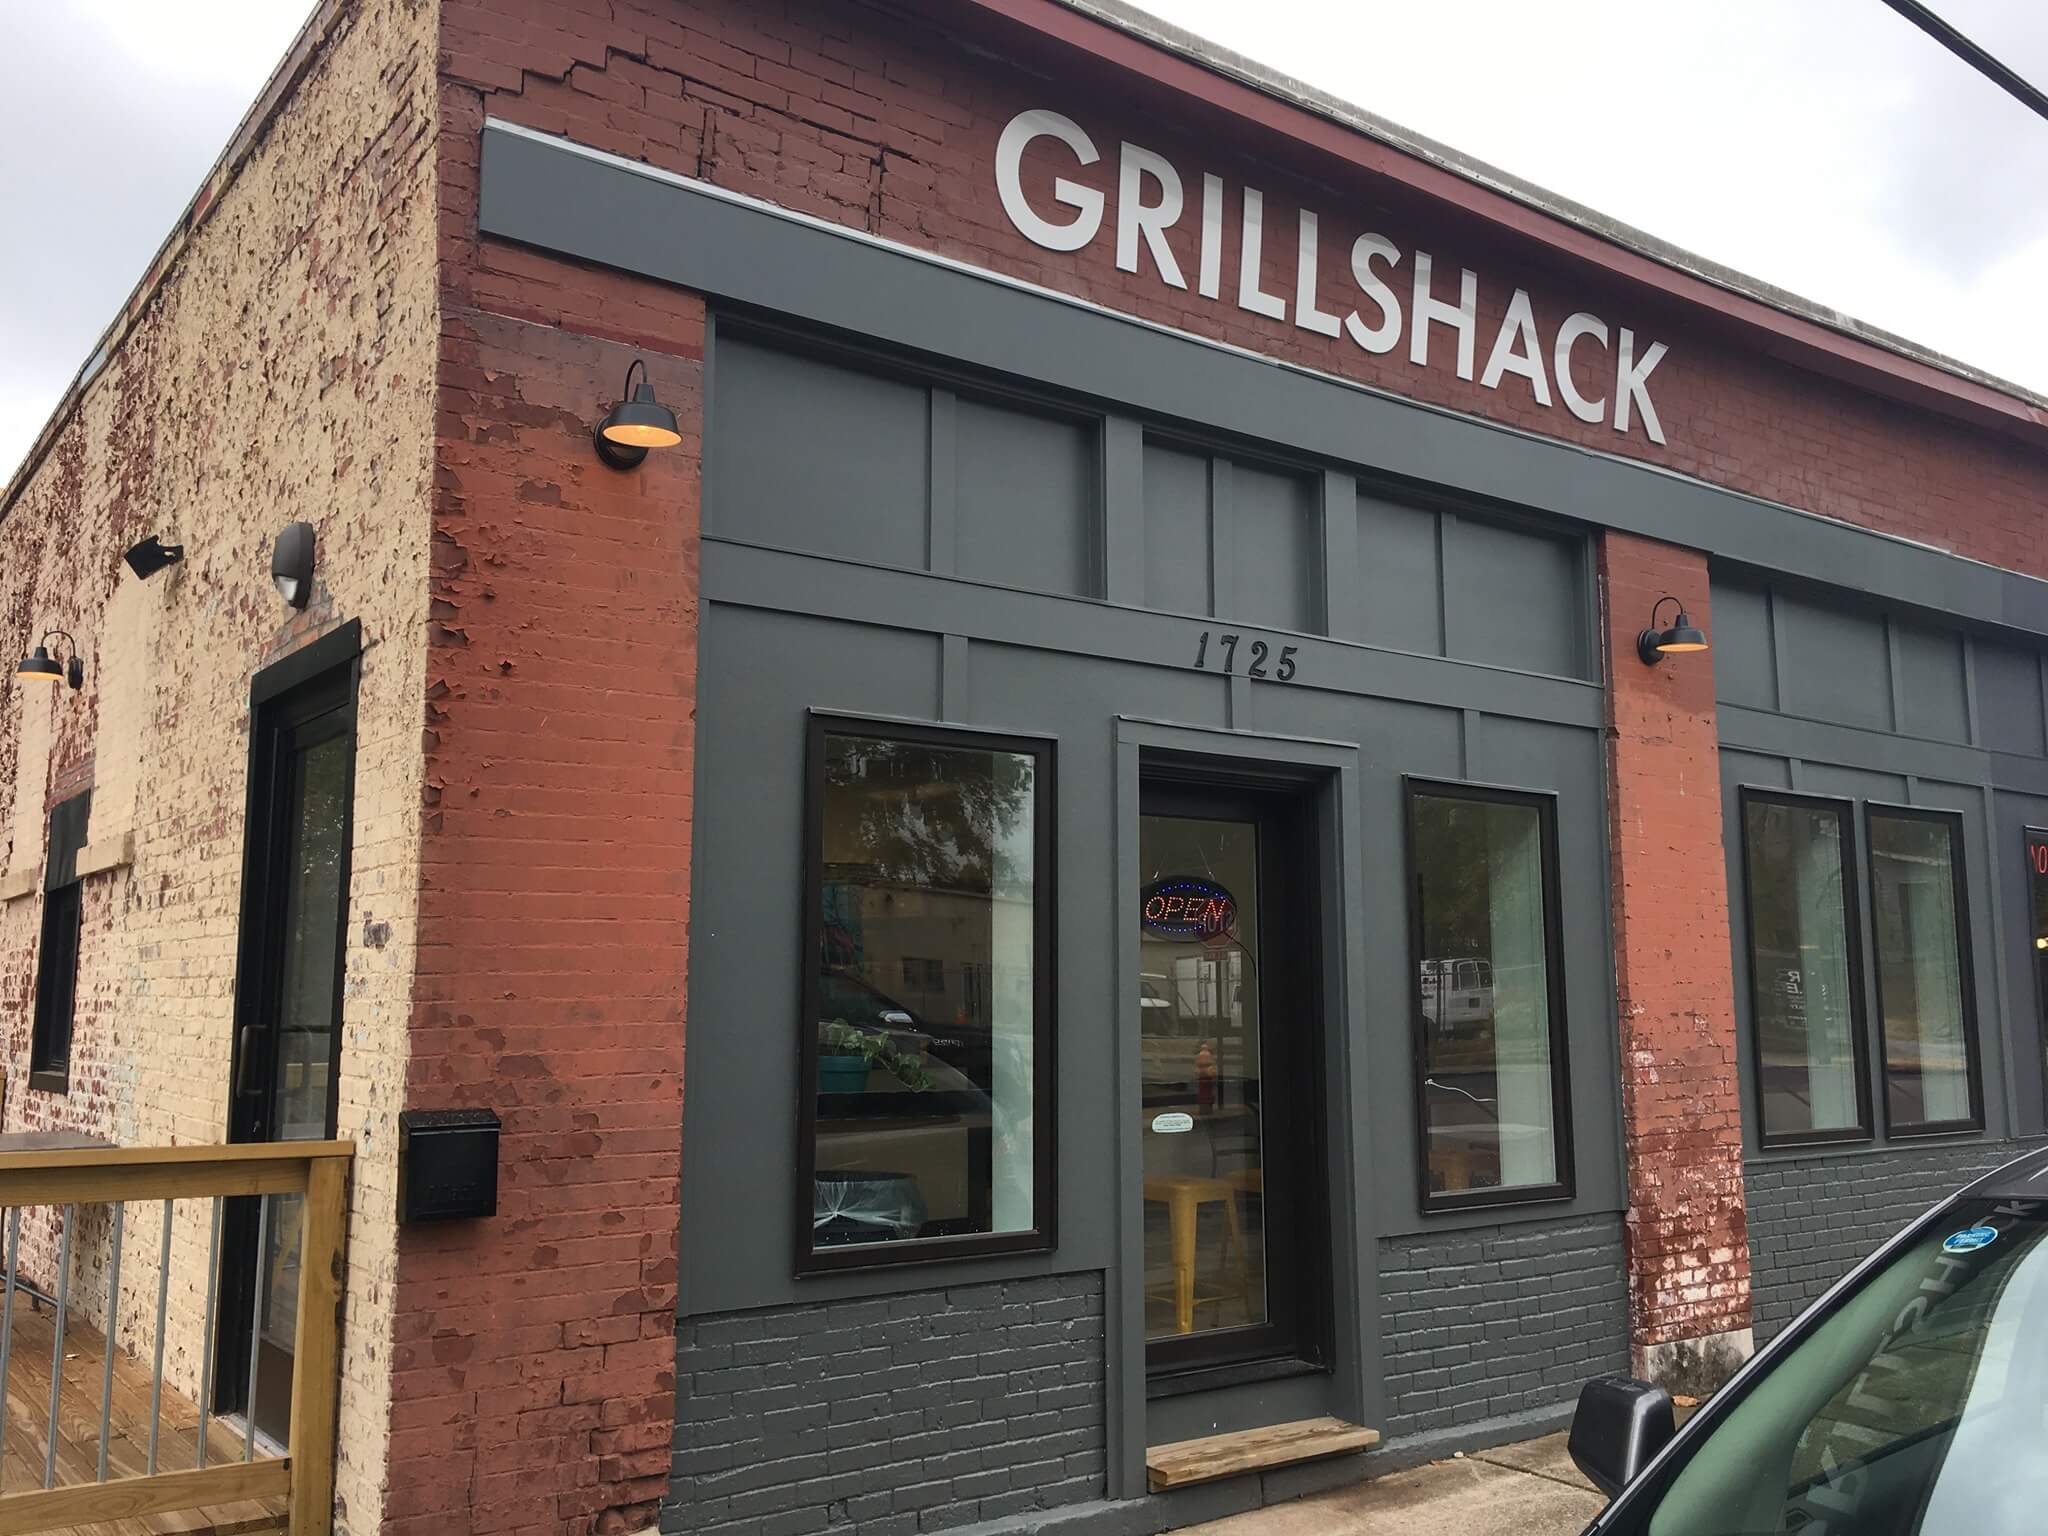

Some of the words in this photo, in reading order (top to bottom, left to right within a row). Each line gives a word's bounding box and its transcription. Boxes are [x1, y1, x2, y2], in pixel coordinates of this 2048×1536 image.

[995, 109, 1668, 445] GRILLSHACK
[1194, 631, 1298, 681] 1725
[1145, 896, 1226, 921] OPEN
